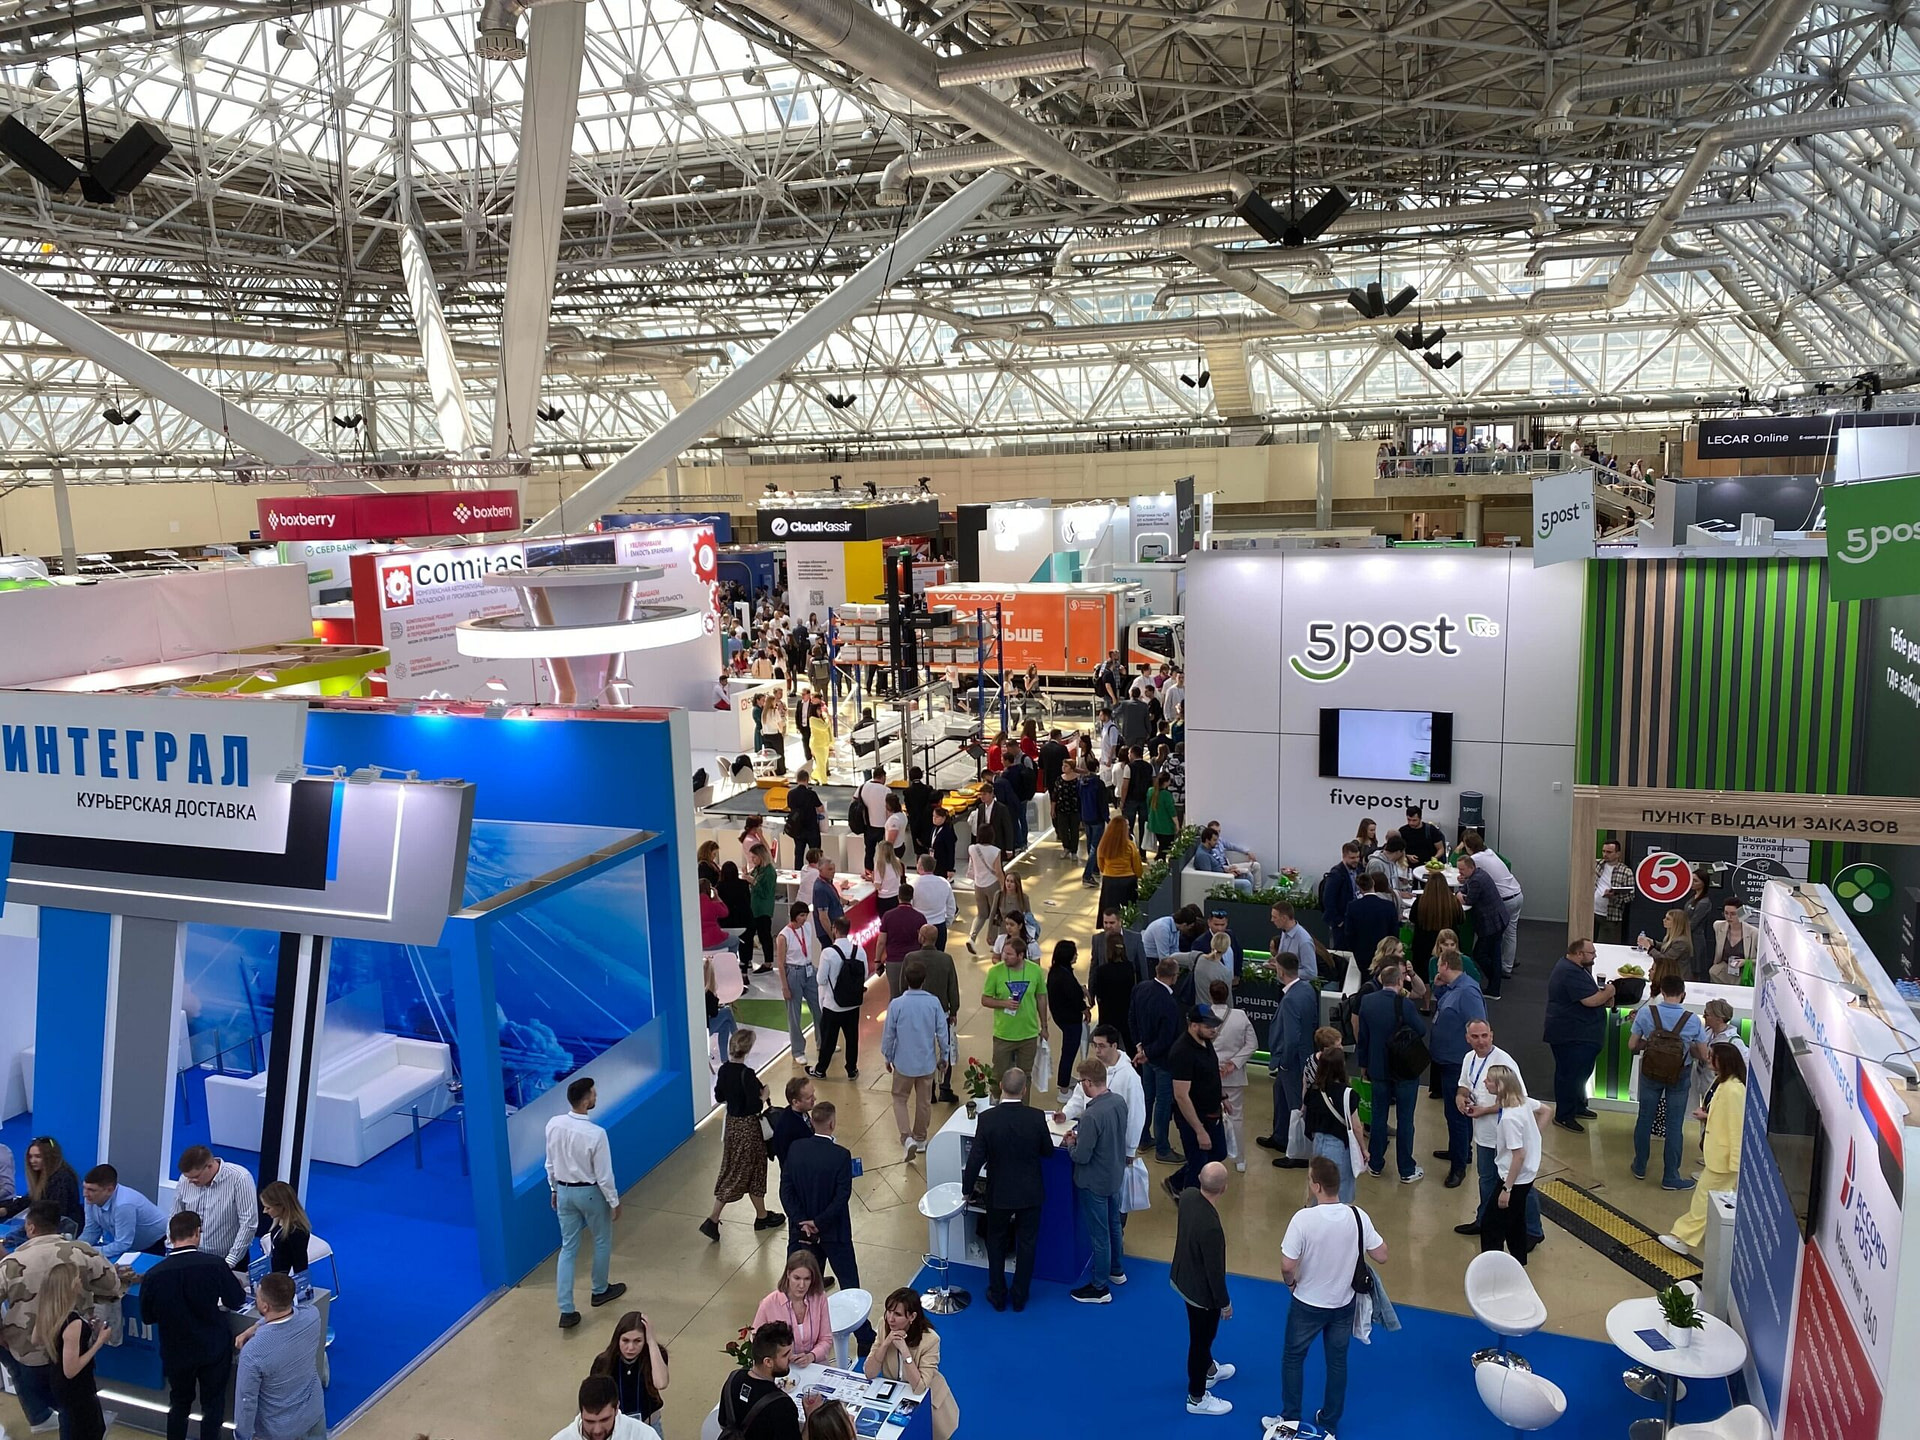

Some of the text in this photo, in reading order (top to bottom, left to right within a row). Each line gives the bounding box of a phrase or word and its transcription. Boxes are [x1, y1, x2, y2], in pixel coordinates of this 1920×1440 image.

[1707, 434, 1749, 445] LECAR
[1754, 433, 1789, 443] Online
[280, 512, 336, 528] boxberry
[473, 505, 513, 520] boxberry
[790, 521, 852, 532] CloudKassir
[1538, 503, 1580, 539] 5post
[416, 554, 522, 586] comitas
[1290, 616, 1457, 680] 5post
[1890, 626, 1907, 656] Тебе
[1886, 666, 1899, 690] где
[2, 724, 249, 788] ИНТЕГРАЛ
[77, 791, 257, 821] КУРЬЕРСКАЯ ДОСТАВКА
[1641, 809, 1899, 834] ПУНКТ ВЫДАЧИ ЗАКАЗОВ
[1742, 836, 1777, 844] Выдача
[1749, 844, 1794, 852] отправка
[1784, 961, 1805, 1008] РЕШЕНИЕ
[1804, 998, 1816, 1033] для
[1816, 1018, 1854, 1110] eCommerce
[1854, 1213, 1874, 1270] POST
[1856, 1190, 1887, 1270] ACCORD
[1836, 1219, 1877, 1346] Маркетинг 360
